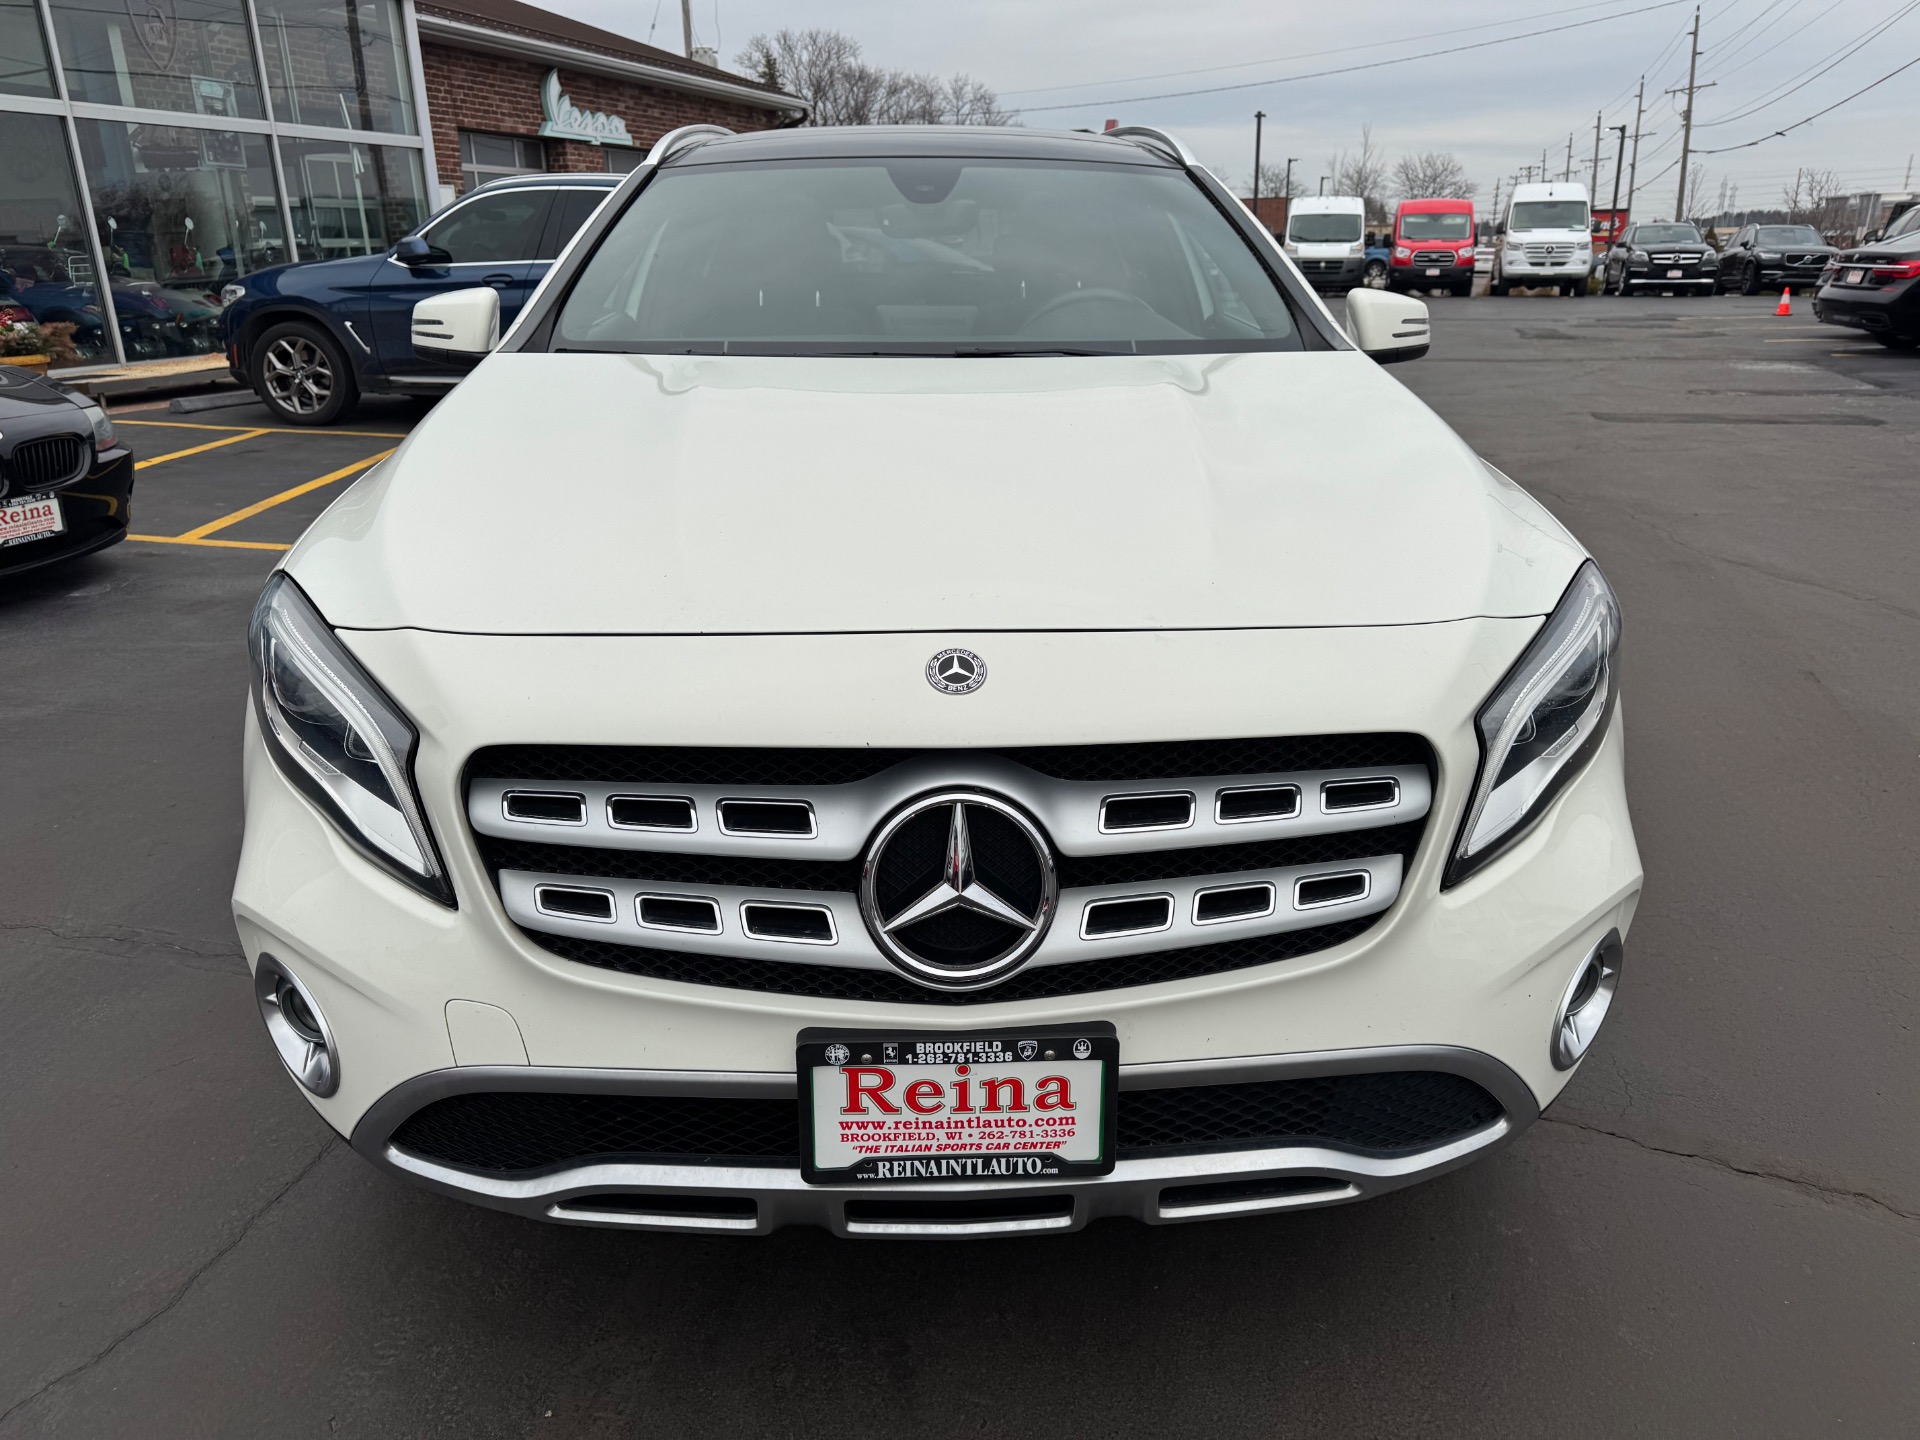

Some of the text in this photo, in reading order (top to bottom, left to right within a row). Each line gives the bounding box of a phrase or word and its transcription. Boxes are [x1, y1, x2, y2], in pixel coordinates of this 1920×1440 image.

[543, 67, 632, 143] Vespa
[0, 504, 53, 526] Reina
[937, 649, 974, 658] MERCEDES
[947, 684, 969, 692] BENZ
[916, 1041, 1002, 1054] BROOKFIELD
[905, 1051, 1013, 1064] 1-262-781-3336
[839, 1063, 1077, 1115] Reina
[838, 1115, 1077, 1131] www.reinaintlauto.com
[839, 1128, 1076, 1143] BROOKFIELD, WI 262-781-3336
[852, 1140, 1068, 1154] “THE ITALIAN SPORTS CAR CENTER”
[856, 1157, 1059, 1180] www.REINAINTLAUTO.com
